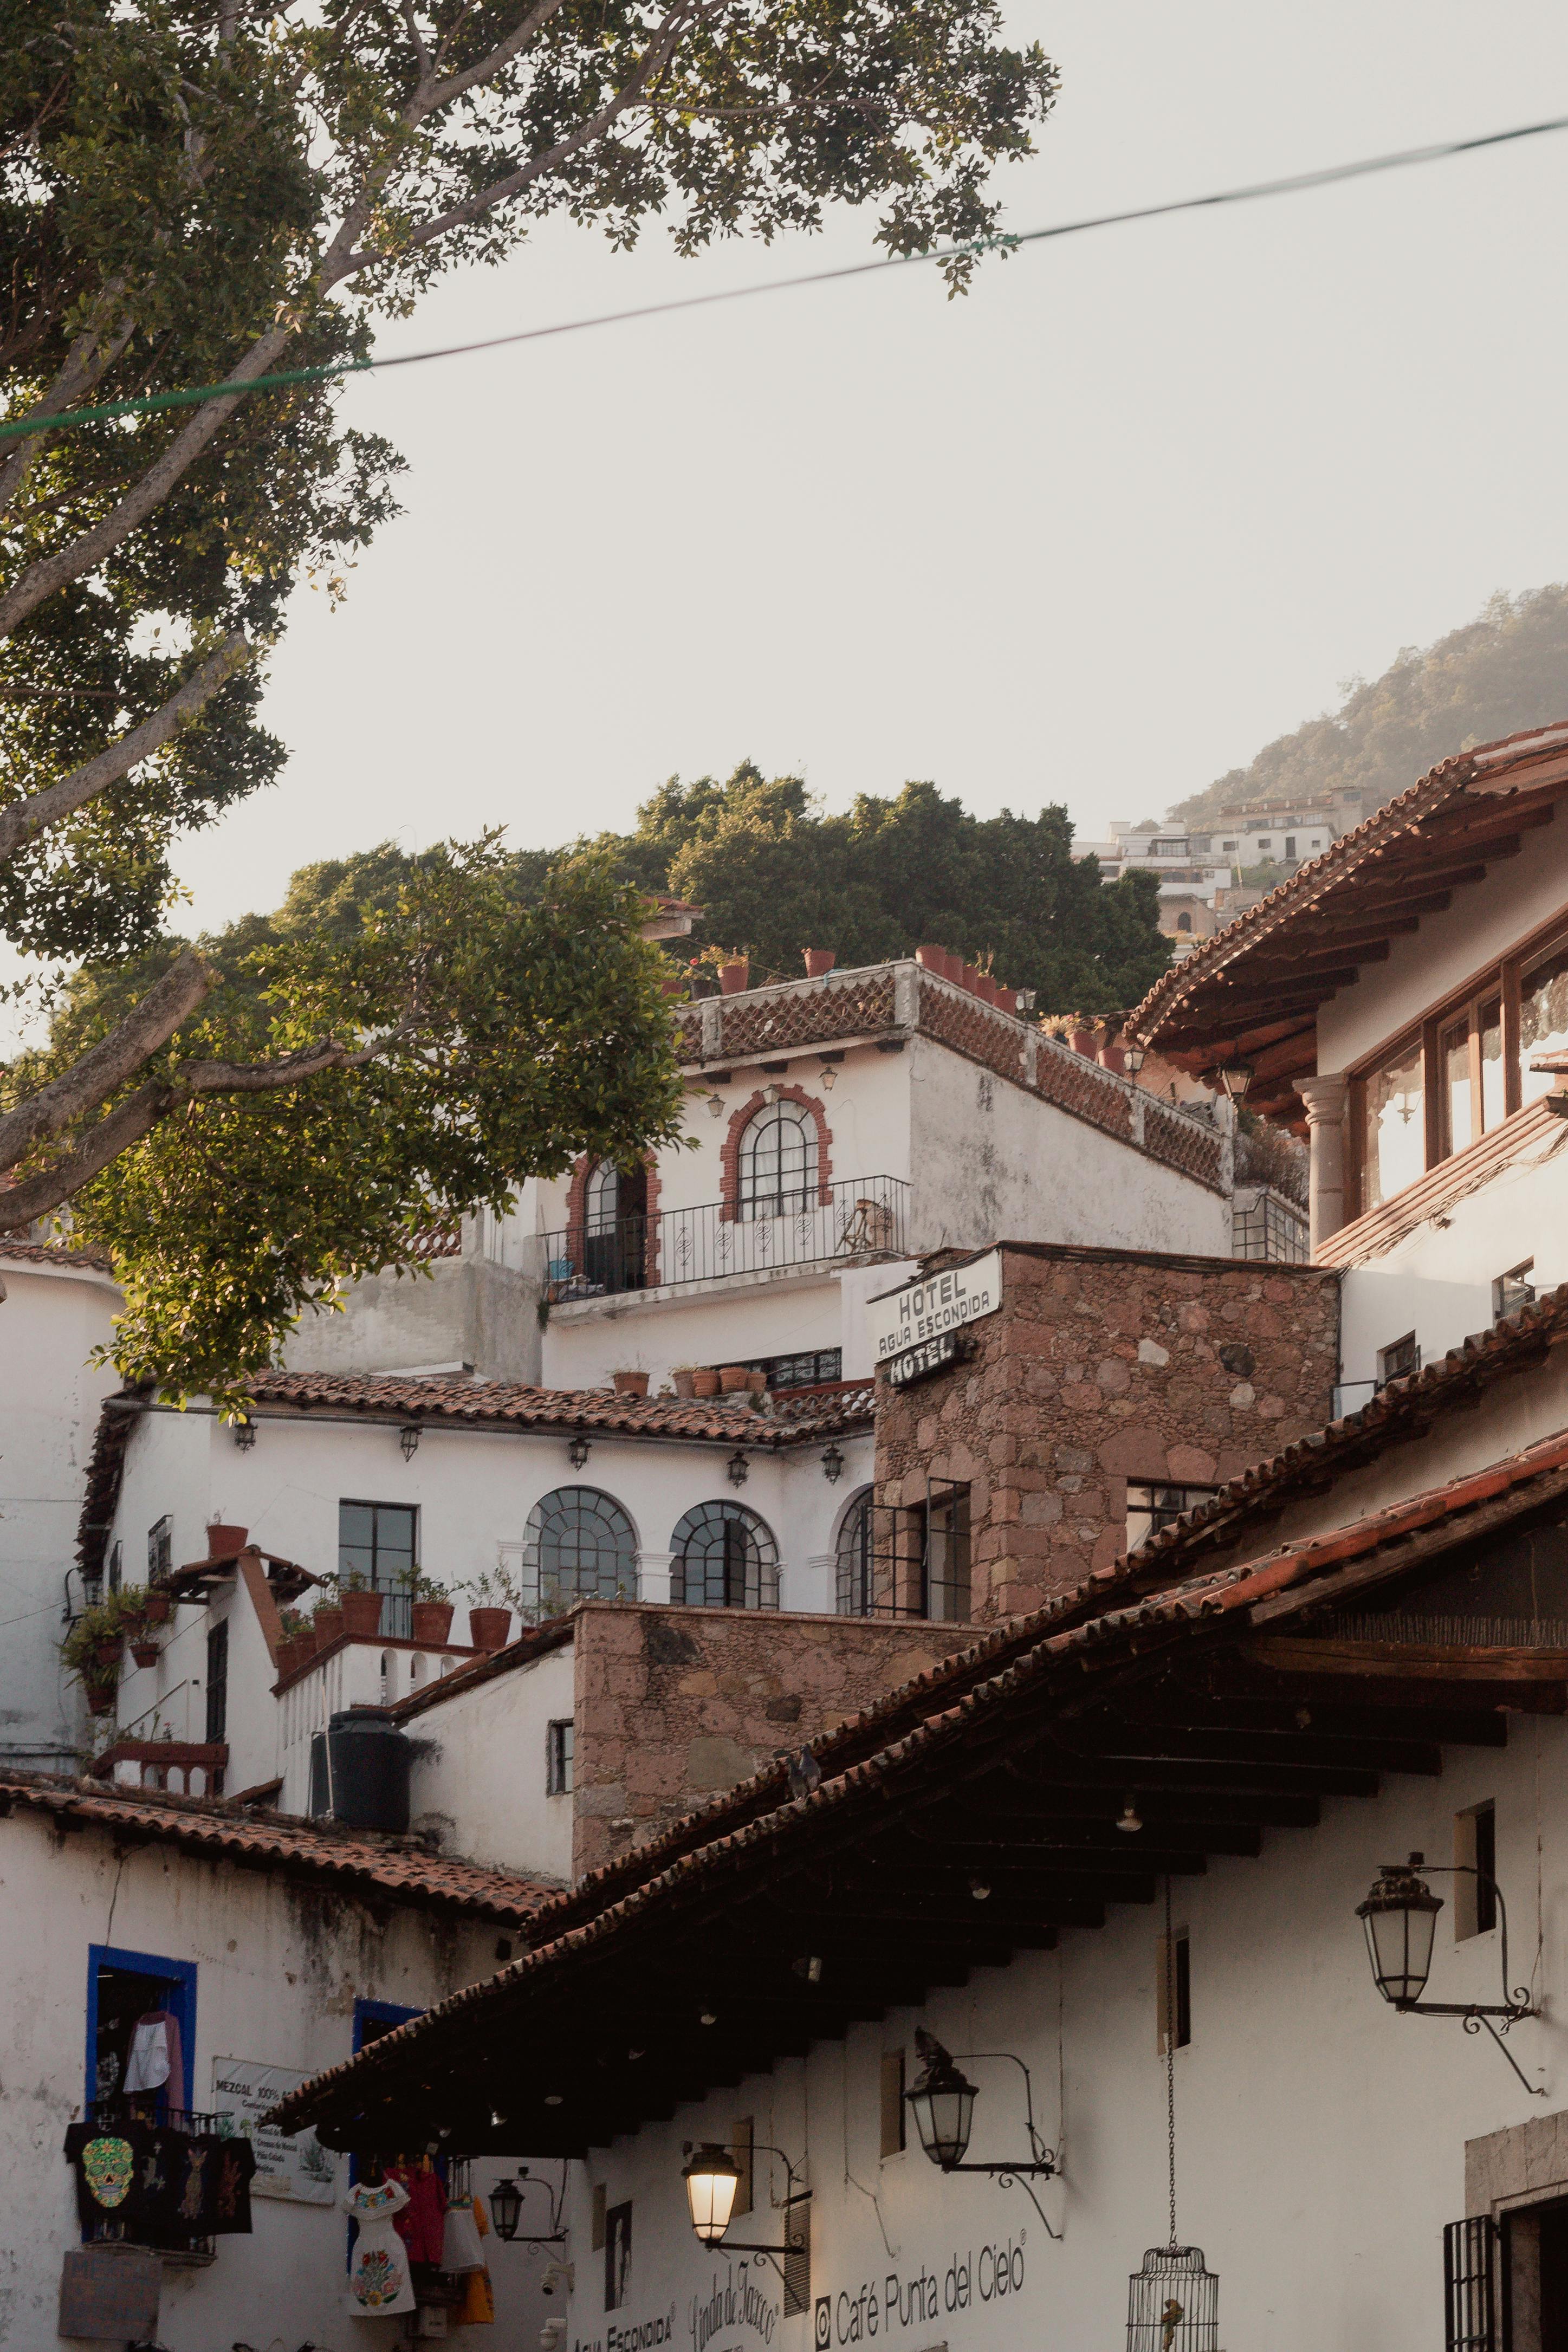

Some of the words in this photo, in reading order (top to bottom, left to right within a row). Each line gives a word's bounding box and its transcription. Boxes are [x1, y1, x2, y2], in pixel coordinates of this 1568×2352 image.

[879, 1327, 911, 1355] AGUA
[917, 1291, 989, 1339] ESCONDIDA
[899, 1272, 966, 1324] HOTEL
[890, 1336, 953, 1384] HOTEL
[216, 2079, 252, 2096] MEZCAL
[837, 2281, 878, 2345] Café
[885, 2265, 939, 2332] Punta
[945, 2251, 971, 2313] del
